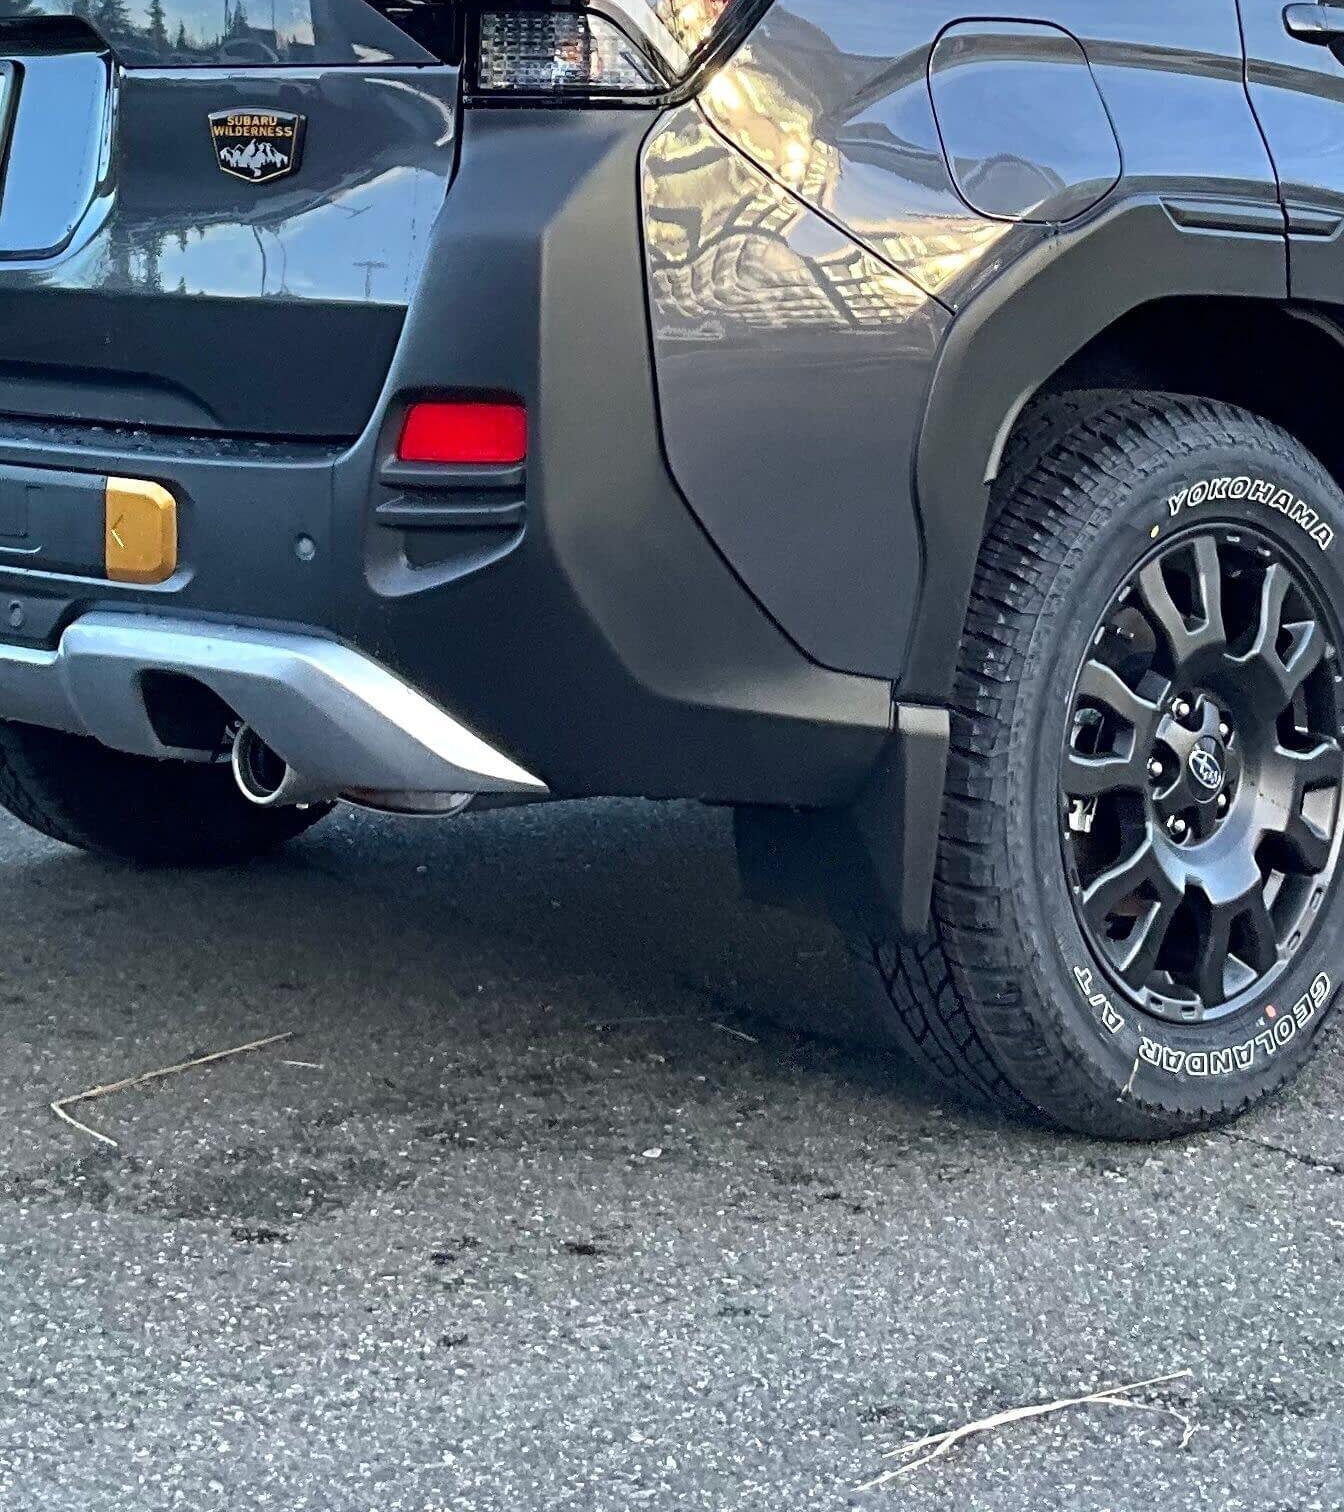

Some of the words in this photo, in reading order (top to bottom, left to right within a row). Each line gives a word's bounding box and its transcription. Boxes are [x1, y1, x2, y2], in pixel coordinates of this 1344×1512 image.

[214, 126, 293, 137] WILDERNESS
[227, 115, 278, 126] SUBARU
[1167, 475, 1335, 552] YOKOHAMA
[1073, 966, 1125, 1034] A/T
[1138, 971, 1332, 1076] GEOLANDAR
